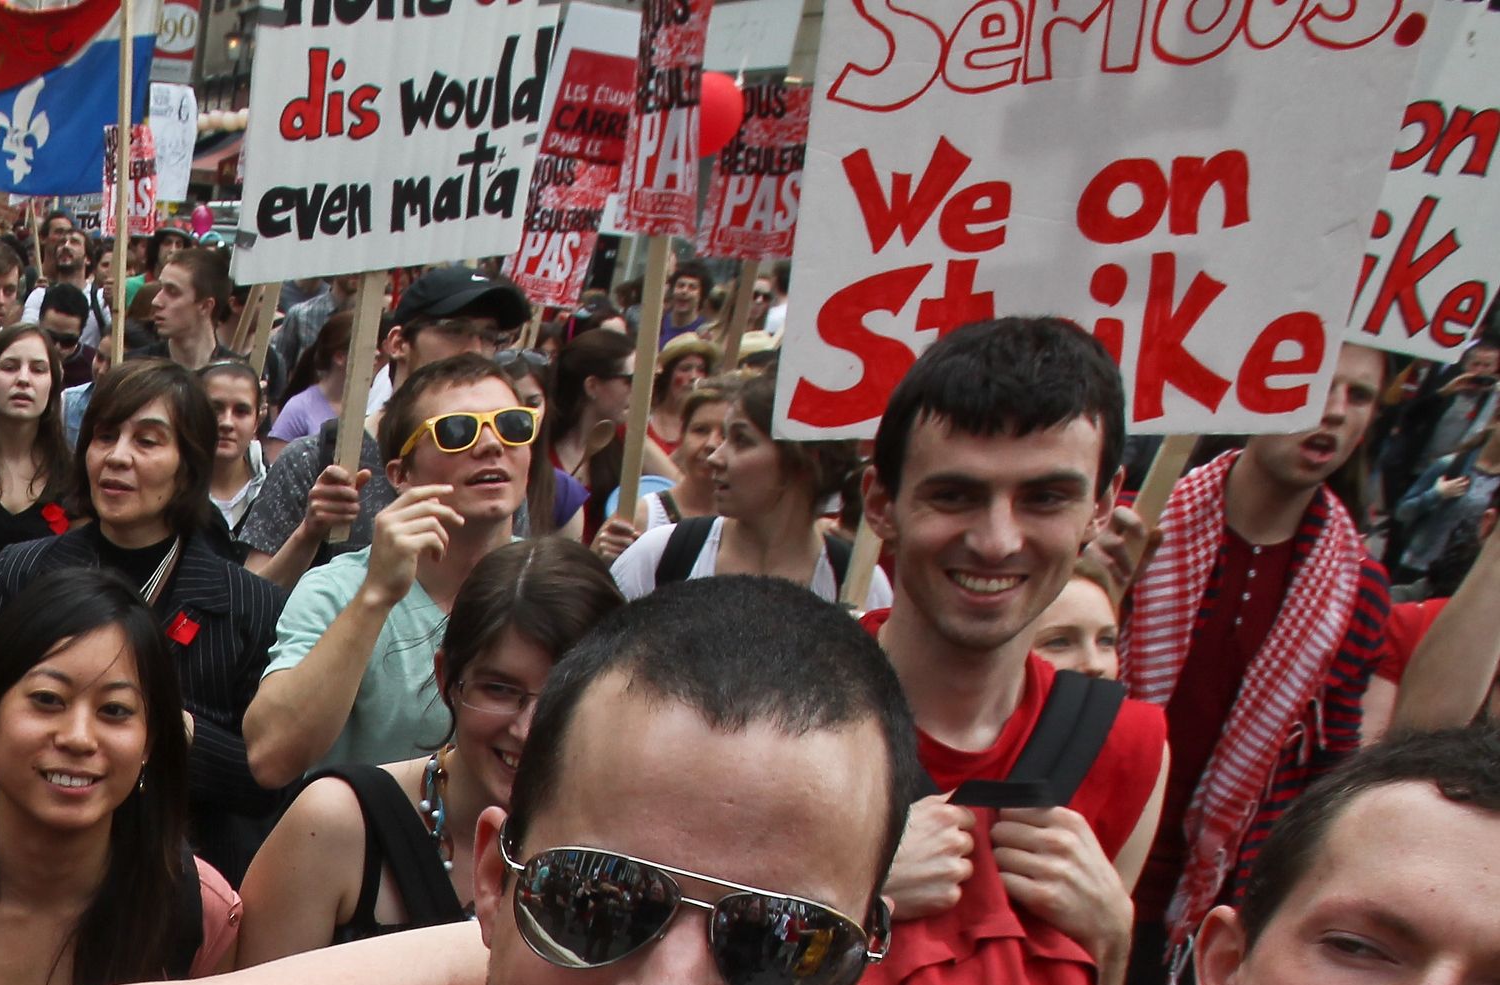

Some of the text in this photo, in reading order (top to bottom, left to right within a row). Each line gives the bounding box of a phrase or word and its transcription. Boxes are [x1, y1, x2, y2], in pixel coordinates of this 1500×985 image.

[279, 26, 555, 141] dis would
[257, 183, 371, 240] even
[720, 170, 801, 233] PAS
[841, 135, 1251, 254] We on
[517, 231, 581, 281] PAS
[787, 252, 1330, 428] Stike
